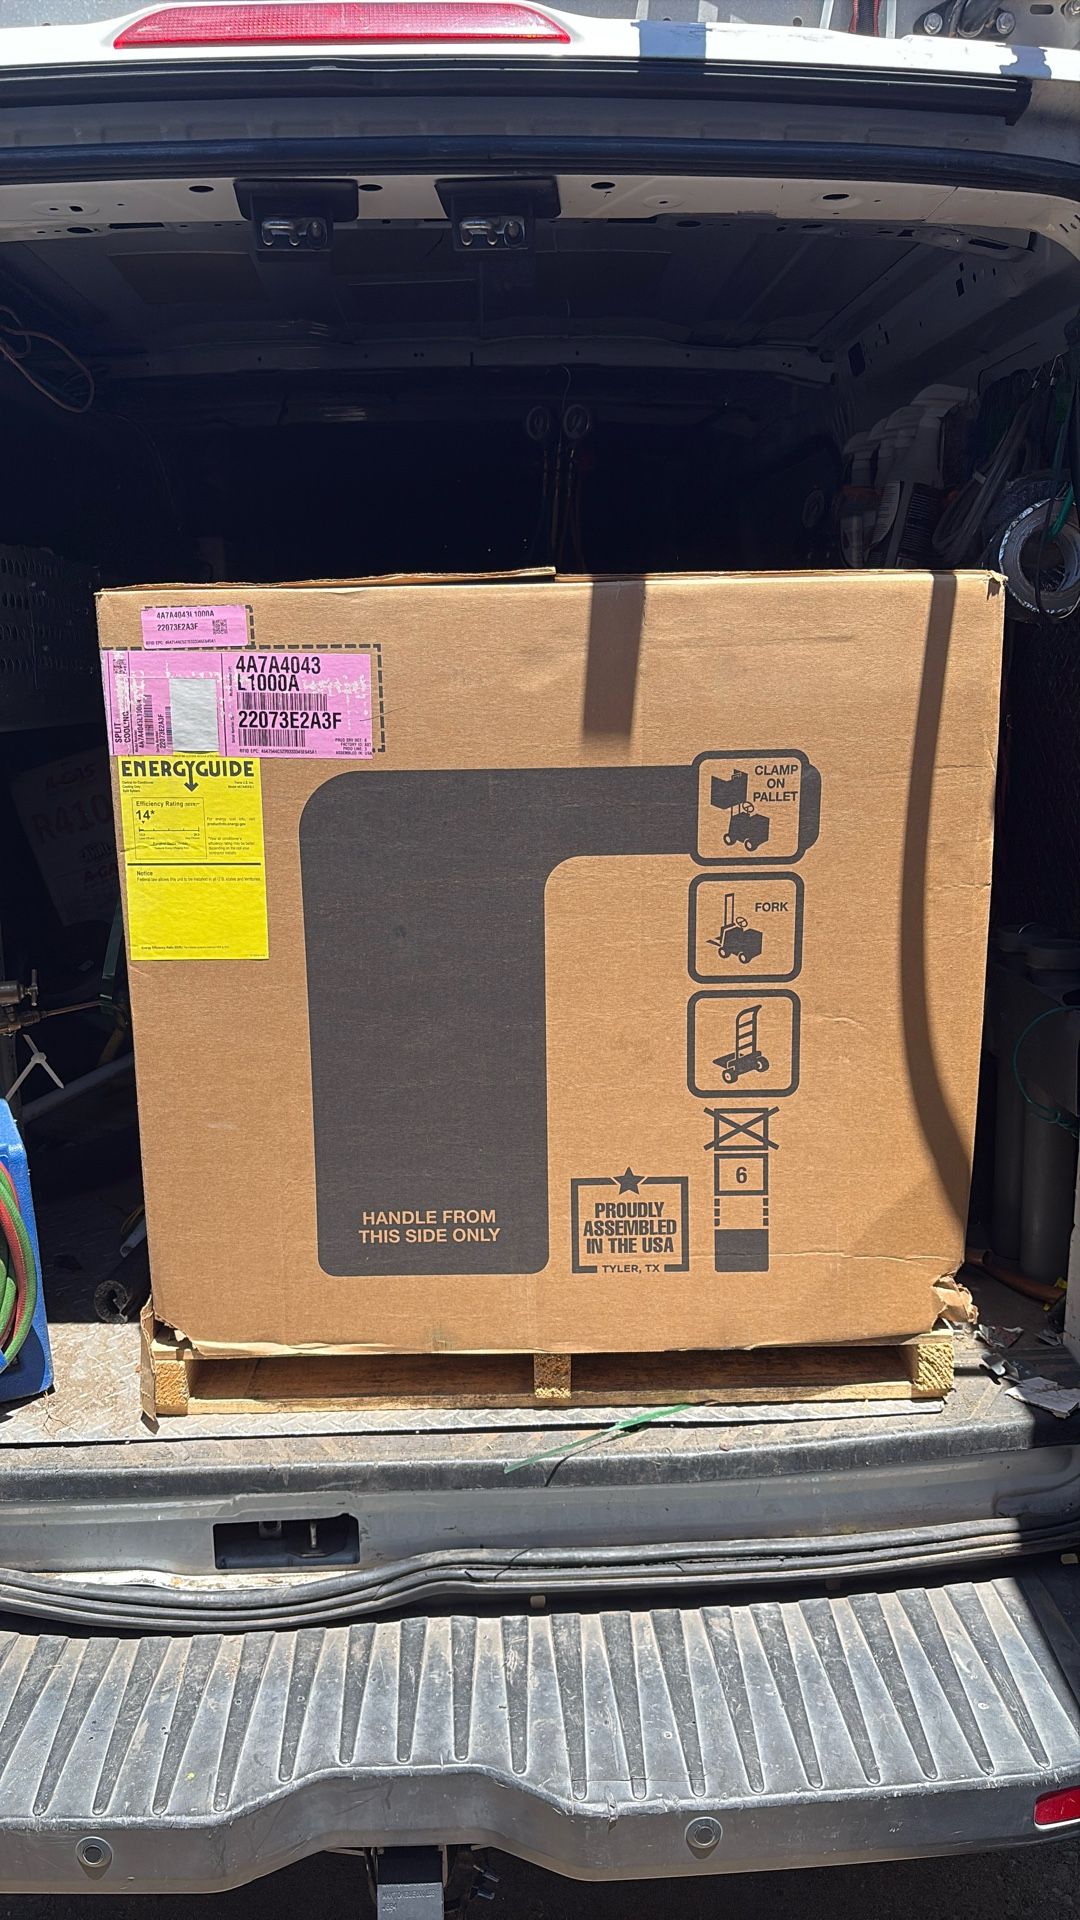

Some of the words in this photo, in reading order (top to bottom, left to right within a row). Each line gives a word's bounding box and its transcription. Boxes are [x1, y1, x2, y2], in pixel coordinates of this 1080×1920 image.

[156, 622, 199, 632] 22073E2A3F
[236, 656, 321, 674] 4A7A4043
[237, 674, 300, 692] L1000A
[238, 711, 342, 729] 22073E2A3F
[114, 723, 122, 743] SPLIT
[158, 714, 166, 749] 22073E2A3F
[122, 760, 254, 778] ENERGYGUIDE
[754, 765, 798, 776] CLAMP
[766, 778, 785, 789] ON
[753, 791, 798, 802] PALLET
[755, 902, 788, 912] FORK
[736, 1167, 748, 1184] 6
[362, 1210, 438, 1226] HANDLE
[443, 1209, 496, 1224] FROM
[594, 1202, 664, 1218] PROUDLY
[359, 1229, 401, 1244] THIS
[405, 1228, 447, 1243] SIDE
[452, 1228, 500, 1242] ONLY
[584, 1219, 677, 1237] ASSEMBLED
[586, 1238, 602, 1254] IN
[608, 1238, 638, 1254] THE
[642, 1237, 674, 1253] USA
[602, 1264, 642, 1274] TYLER,
[645, 1264, 660, 1273] TX
